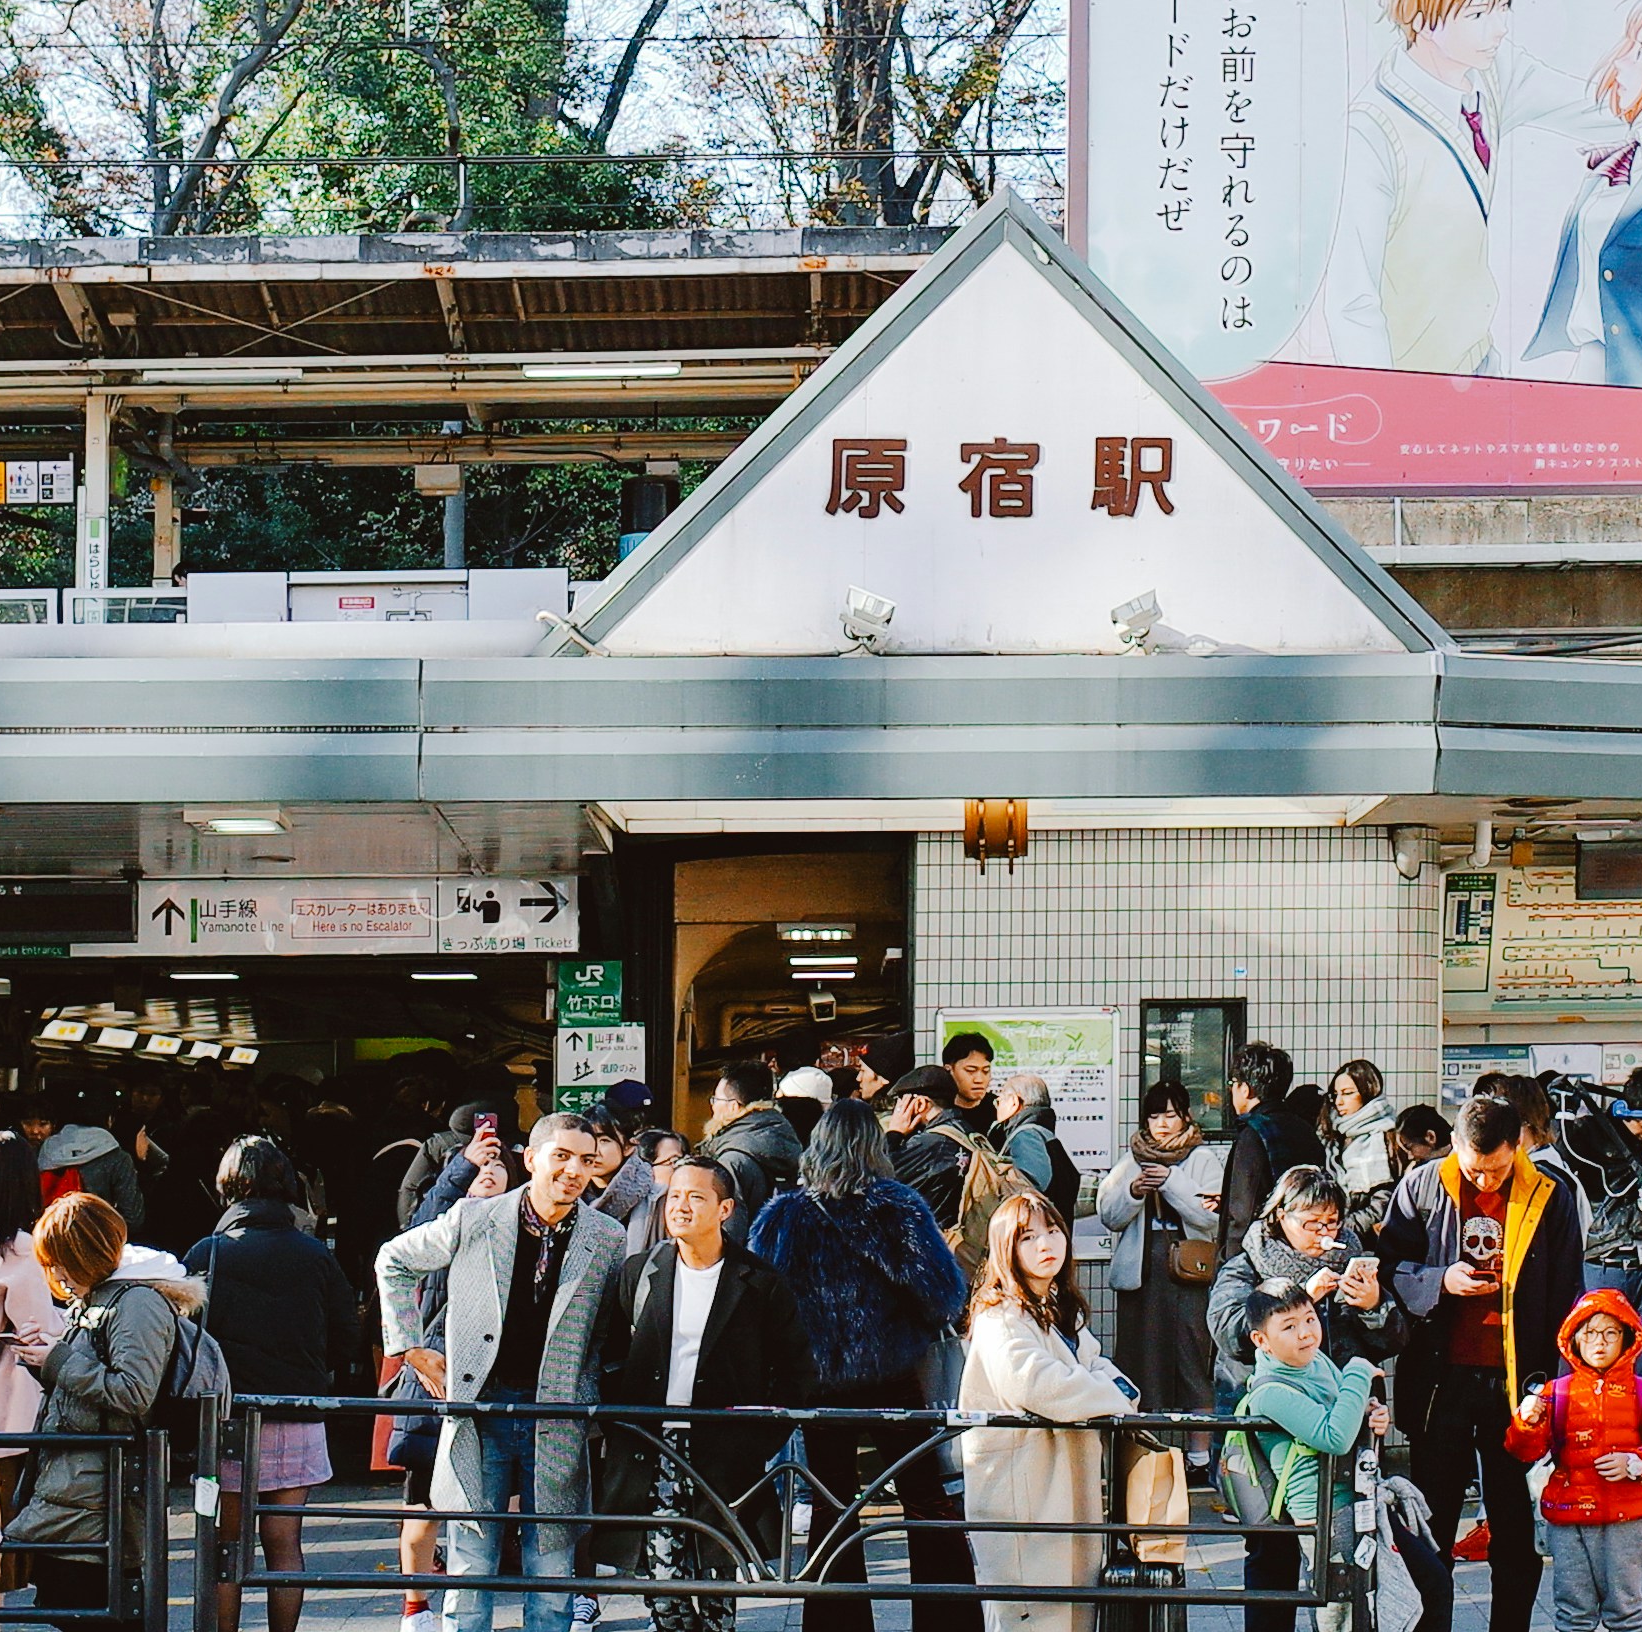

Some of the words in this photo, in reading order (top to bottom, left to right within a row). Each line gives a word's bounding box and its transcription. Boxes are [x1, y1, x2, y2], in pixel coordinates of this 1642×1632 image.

[823, 435, 1176, 521] 原宿駅
[199, 898, 258, 919] 山手線
[295, 902, 429, 917] エスカレーターはありません
[199, 921, 257, 934] Yamanote
[260, 921, 285, 933] Line
[311, 919, 338, 932] Here
[339, 919, 348, 932] is
[349, 922, 363, 932] no
[365, 919, 412, 932] Escalator
[441, 935, 526, 951] きっぷ売り場
[533, 936, 574, 949] Tickets
[575, 964, 605, 981] JR
[566, 994, 615, 1011] 竹下口
